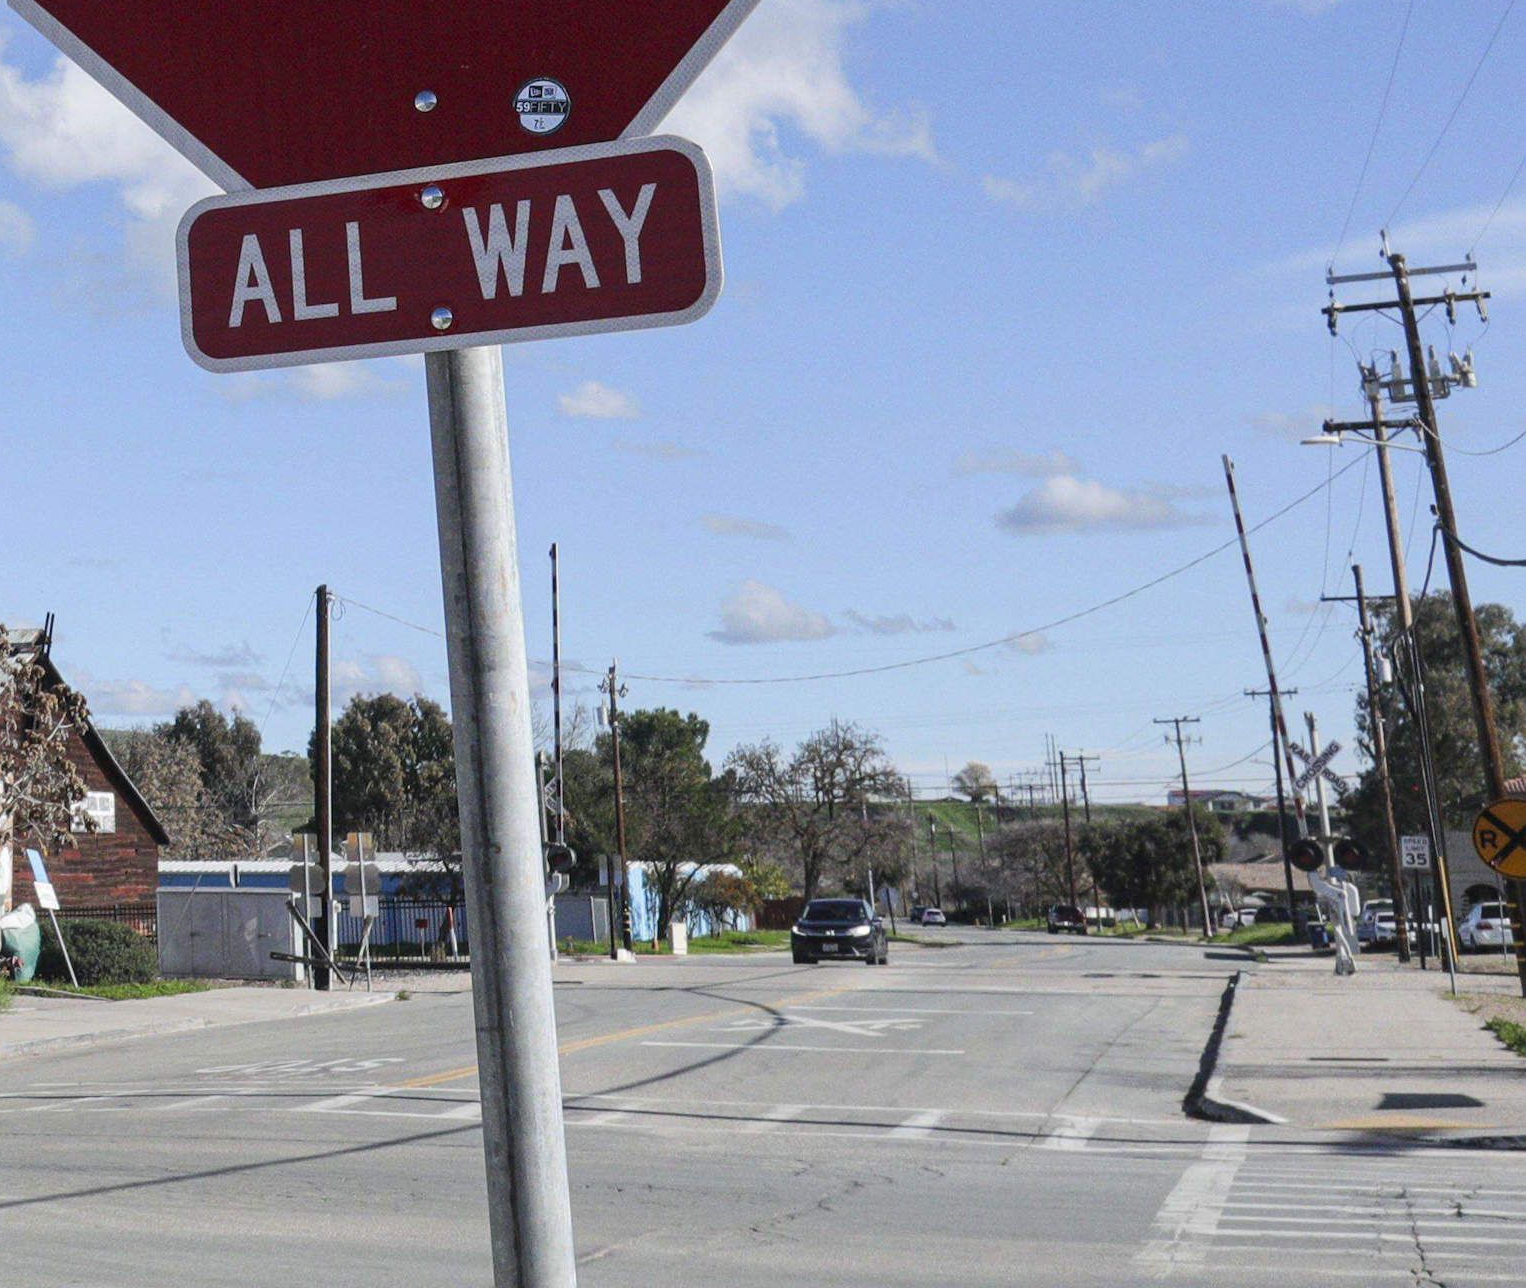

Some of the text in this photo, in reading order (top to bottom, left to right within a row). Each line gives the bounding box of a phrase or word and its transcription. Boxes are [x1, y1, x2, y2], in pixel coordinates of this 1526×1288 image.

[515, 101, 567, 113] 59FIFTY
[228, 182, 658, 328] ALL WAY
[1290, 742, 1347, 790] RAIL ROAD
[1295, 742, 1340, 790] CROSSING
[1480, 829, 1499, 850] R
[1405, 853, 1428, 866] 35
